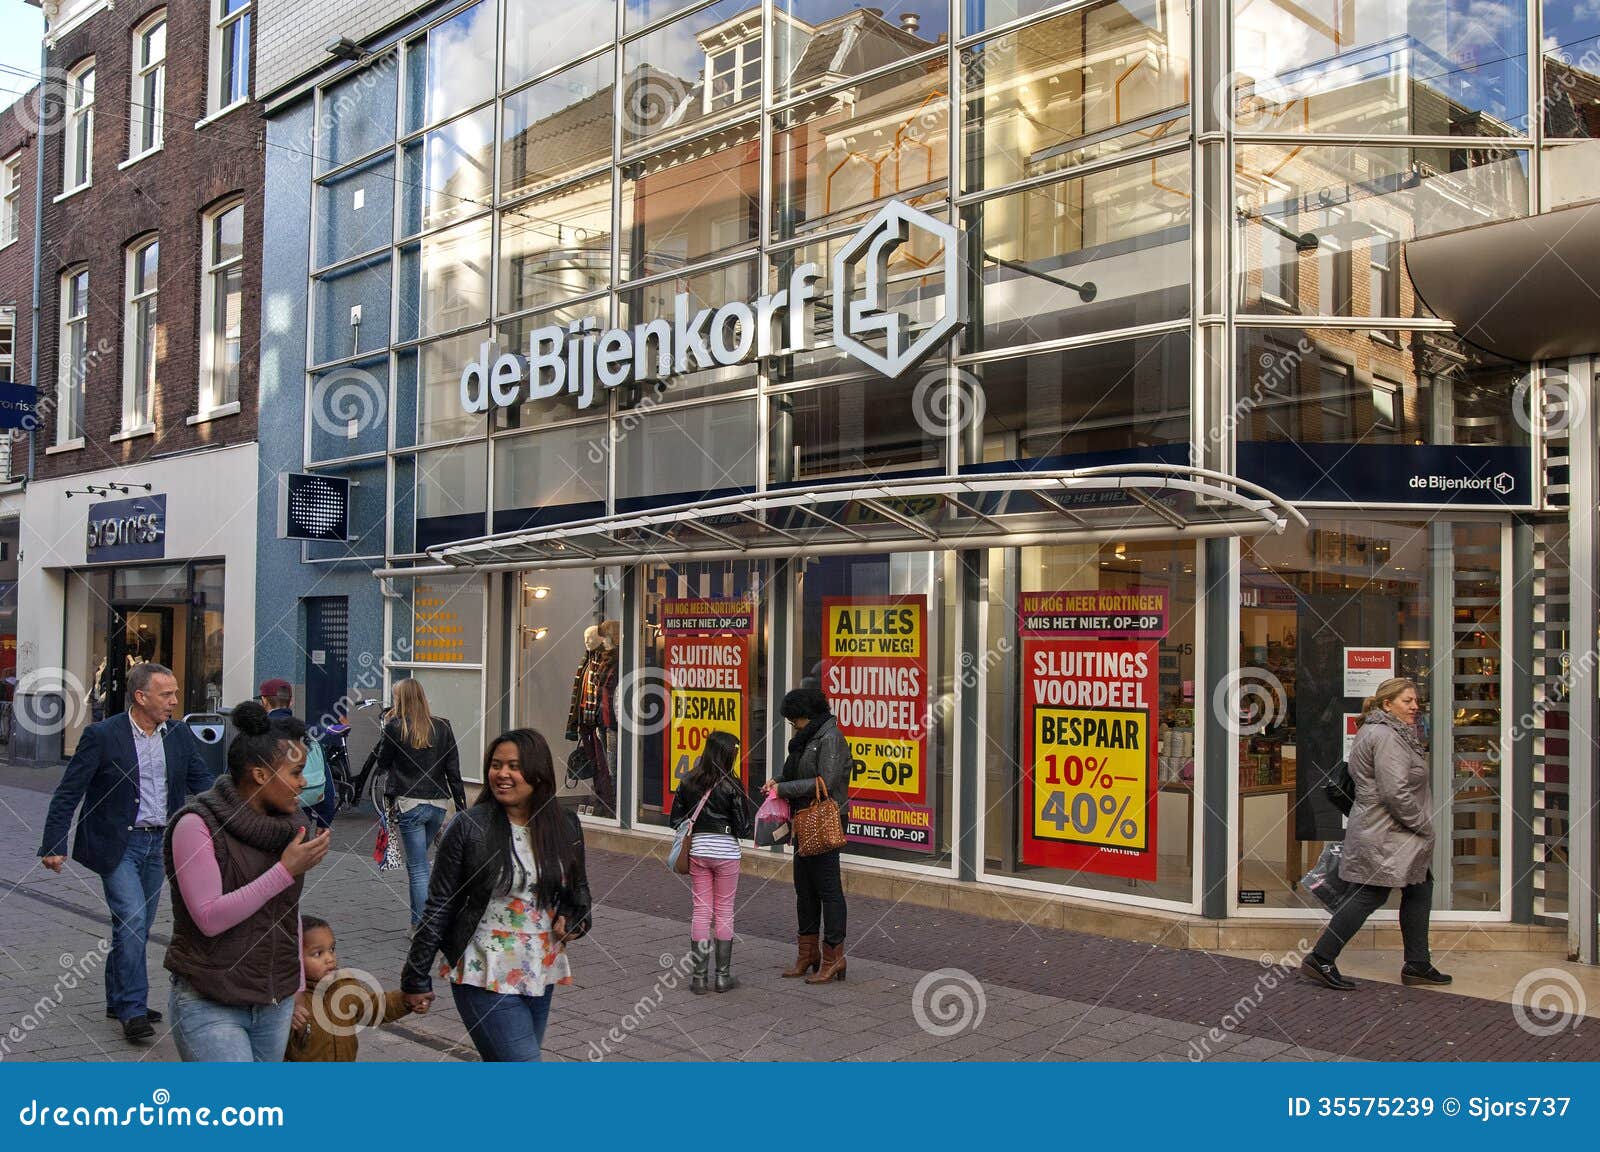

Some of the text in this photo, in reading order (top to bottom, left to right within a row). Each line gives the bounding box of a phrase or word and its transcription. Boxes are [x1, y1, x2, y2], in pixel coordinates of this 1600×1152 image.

[460, 262, 824, 414] de Bijenkorf
[1409, 476, 1491, 490] de Bijenkorf
[675, 602, 689, 614] NOG
[691, 602, 709, 614] MEER
[1024, 595, 1163, 611] NU NOG MEER KORTINGEN
[667, 618, 748, 628] MIS HET NIET. OP=OP
[836, 609, 914, 635] ALLES
[1028, 616, 1158, 629] MIS HET NIET. OP=OP
[671, 645, 742, 666] SLUITINGS
[835, 638, 914, 652] MOET WEG!
[1034, 651, 1149, 679] SLUITINGS
[1353, 655, 1385, 663] Voordeel
[670, 667, 742, 689] VOORDEEL
[829, 666, 920, 696] SLUITINGS
[1033, 679, 1149, 708] VOORDEEL
[675, 695, 736, 721] BESPAAR
[1042, 715, 1139, 750] BESPAAR
[856, 743, 914, 759] OF NOOIT
[852, 760, 914, 785] P=OP
[852, 806, 929, 826] MEER KORTINGEN
[1041, 790, 1138, 840] 40%
[863, 825, 888, 838] NIET.
[890, 828, 925, 842] OP=OP
